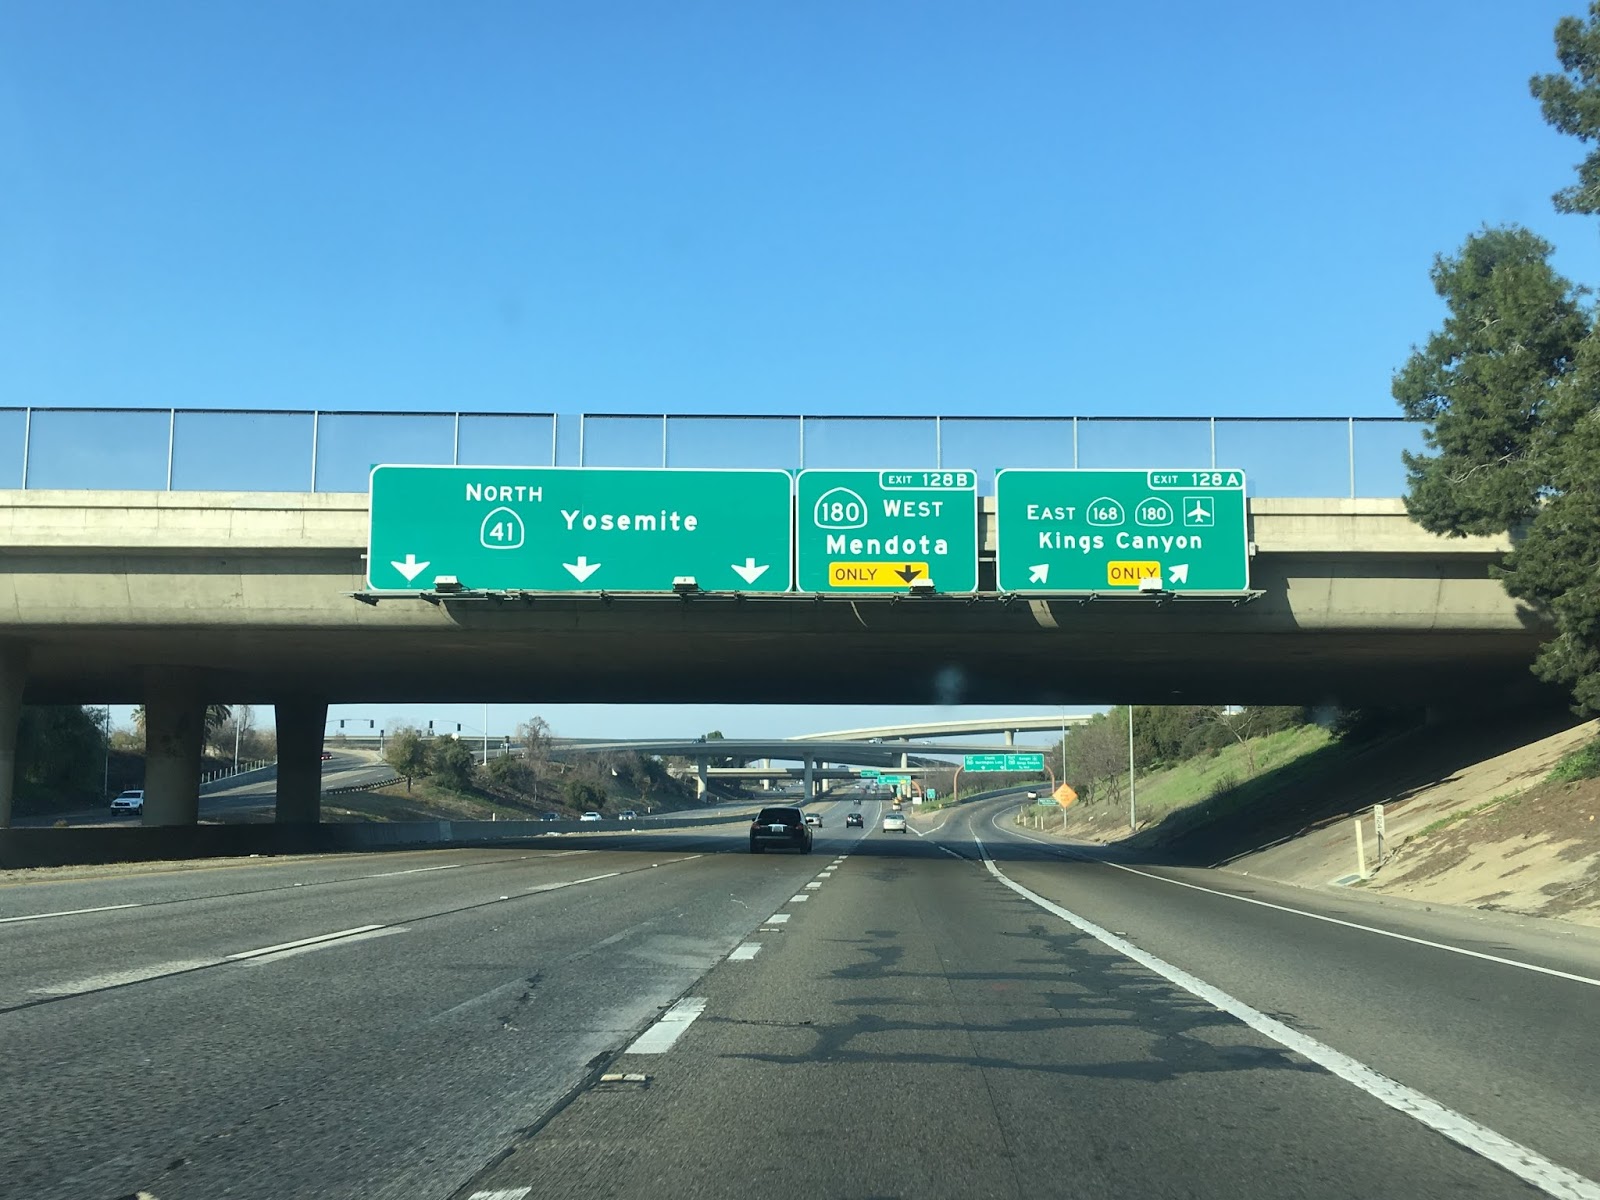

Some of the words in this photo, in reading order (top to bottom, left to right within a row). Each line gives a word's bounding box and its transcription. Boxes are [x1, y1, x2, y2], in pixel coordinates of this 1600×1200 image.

[888, 475, 912, 485] EXIT
[922, 473, 968, 487] 128B
[1154, 475, 1178, 485] EXIT
[1192, 473, 1240, 487] 128A
[466, 483, 543, 502] NORTH
[822, 502, 860, 522] 180
[884, 499, 943, 517] WEST
[1028, 504, 1076, 520] EAST
[1093, 507, 1117, 521] 168
[1142, 507, 1166, 521] 180
[560, 510, 698, 531] Yosemite
[489, 522, 513, 542] 41
[827, 533, 948, 554] Mendota
[1040, 532, 1104, 554] Kings
[1116, 532, 1202, 553] Canyon
[835, 568, 878, 581] ONLY
[1111, 567, 1157, 579] ONLY
